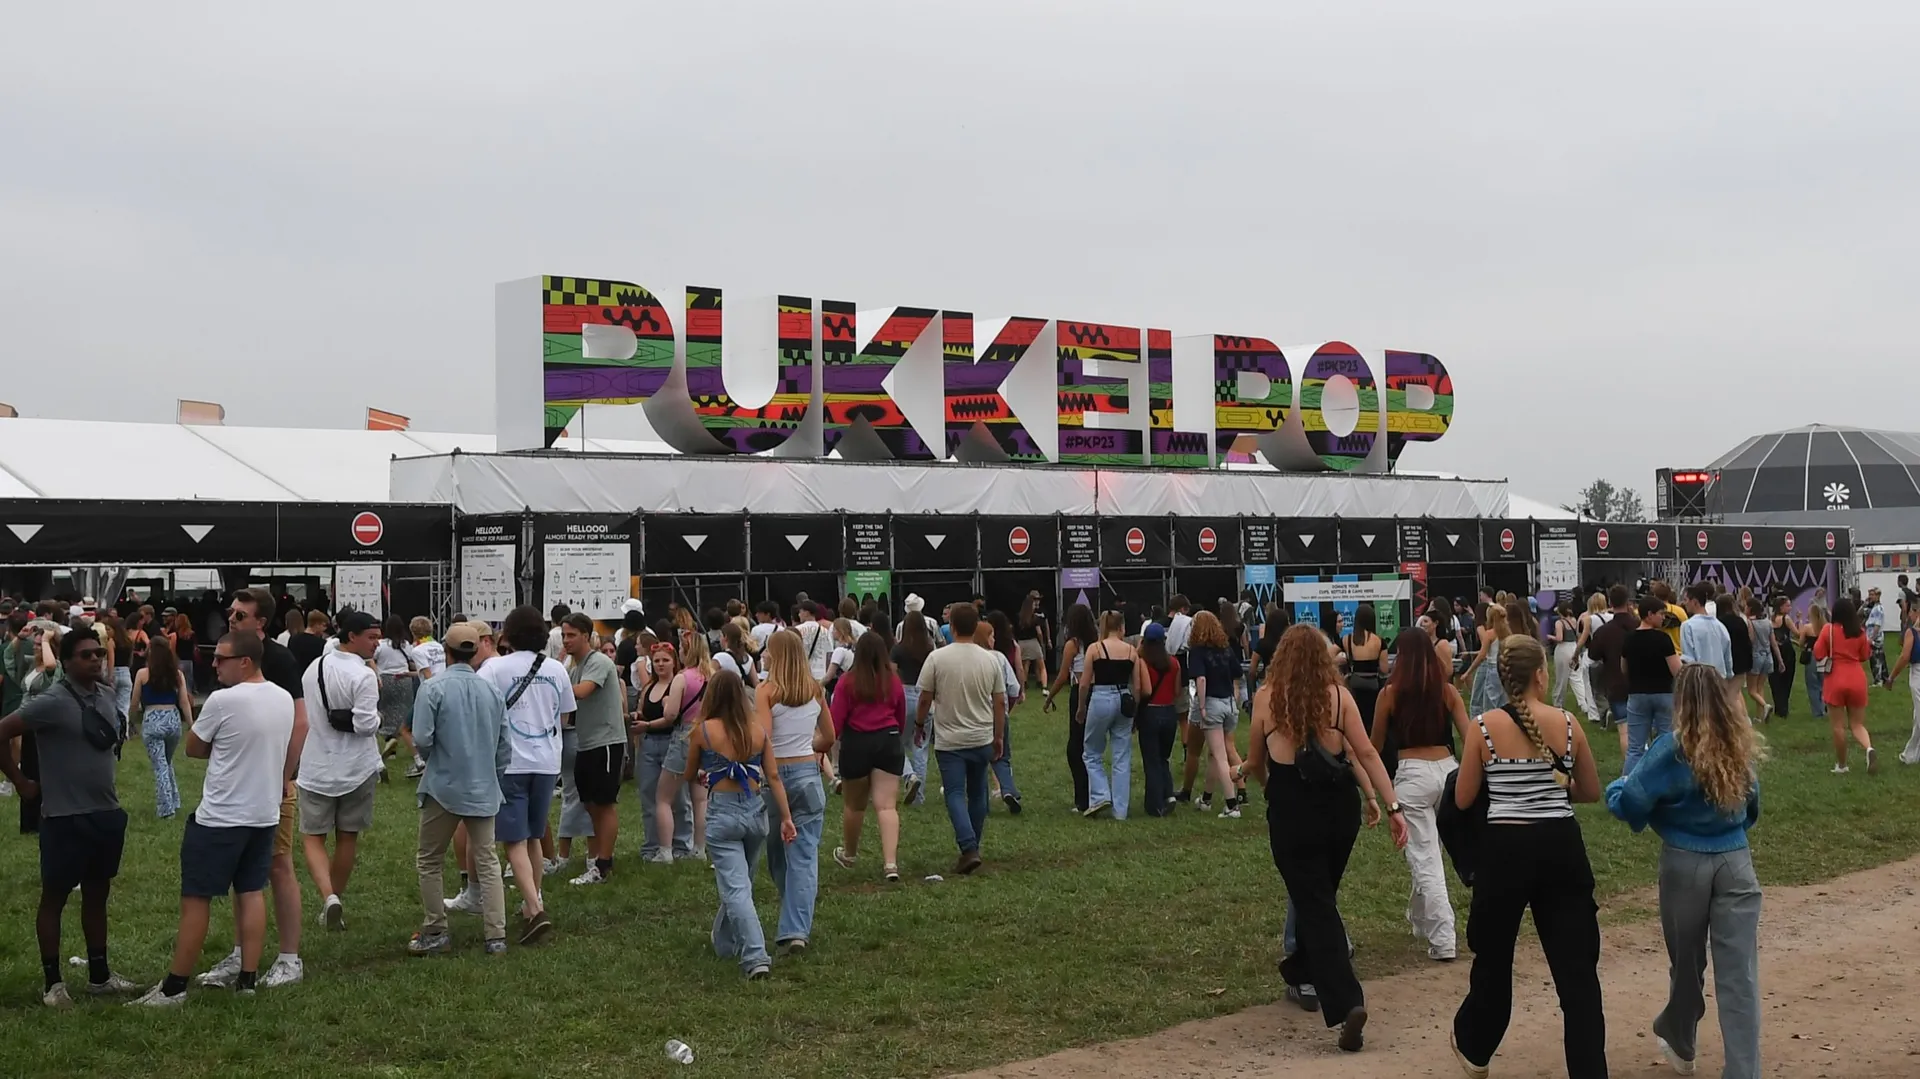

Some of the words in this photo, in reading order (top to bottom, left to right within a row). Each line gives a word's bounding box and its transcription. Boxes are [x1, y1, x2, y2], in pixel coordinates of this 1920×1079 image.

[1317, 359, 1359, 373] #PKP23
[496, 274, 1454, 475] PUKKELPOP
[1065, 435, 1115, 449] #PKP23
[566, 524, 608, 533] HELLOOO!
